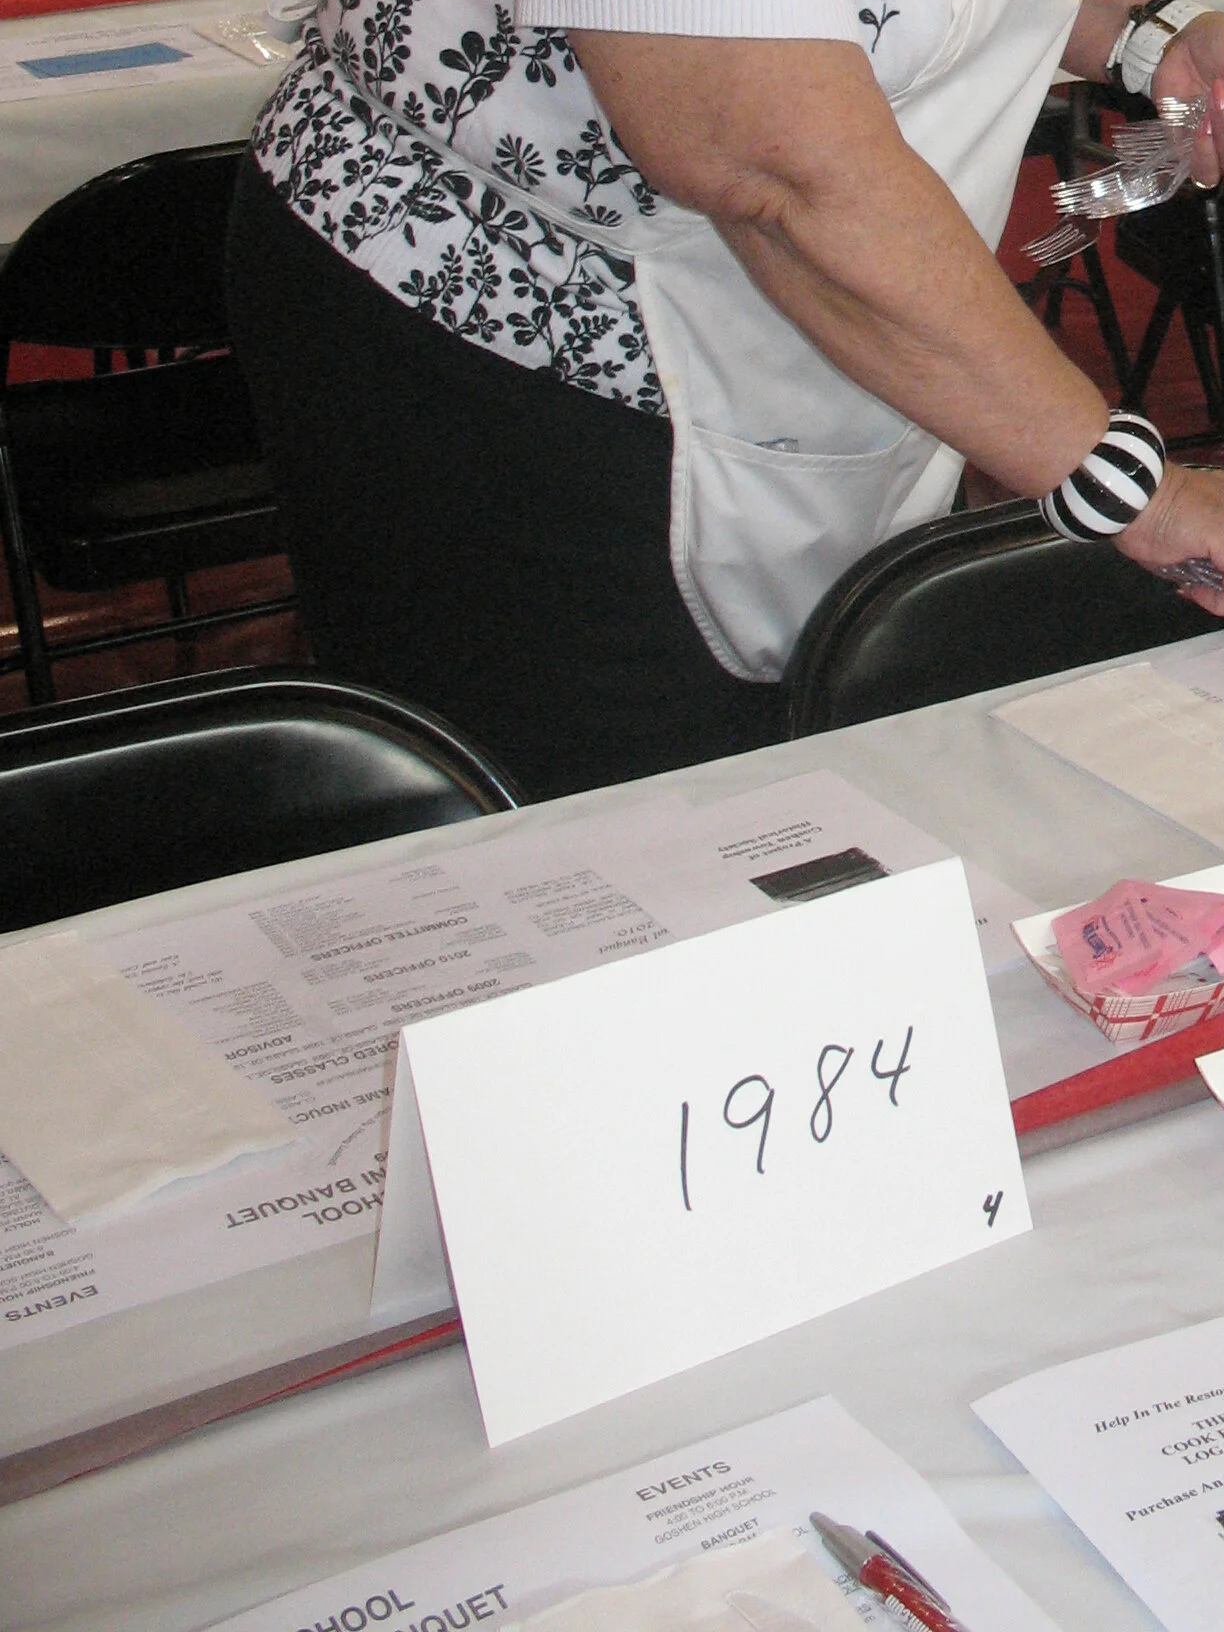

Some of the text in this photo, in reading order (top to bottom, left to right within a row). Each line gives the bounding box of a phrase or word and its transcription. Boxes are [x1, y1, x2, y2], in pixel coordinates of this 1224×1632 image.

[310, 916, 469, 962] COMMITTEE OFFICERS
[363, 959, 434, 984] OFFICERS
[391, 988, 465, 1013] OFFICERS
[270, 1055, 350, 1085] CLASSES
[680, 1024, 915, 1211] 1984
[226, 1178, 357, 1229] BANQUET
[981, 1190, 1003, 1228] 4
[3, 1218, 41, 1233] HOLLY
[26, 1269, 96, 1296] FRIENDSHIP
[5, 1284, 99, 1322] EVENTS
[1093, 1413, 1130, 1434] Help
[1134, 1407, 1151, 1420] In
[1152, 1397, 1181, 1417] The
[1160, 1432, 1218, 1457] COOK
[1181, 1445, 1224, 1466] LOG
[635, 1461, 732, 1502] EVENTS
[646, 1476, 755, 1522] FRIENDSHIP HOUR
[1124, 1488, 1198, 1522] Purchase
[1201, 1478, 1224, 1494] An
[654, 1489, 778, 1545] GOSHEN HIGH SCHOOL
[666, 1495, 729, 1526] 4:00 TO 6:00
[700, 1517, 760, 1551] BANQUET
